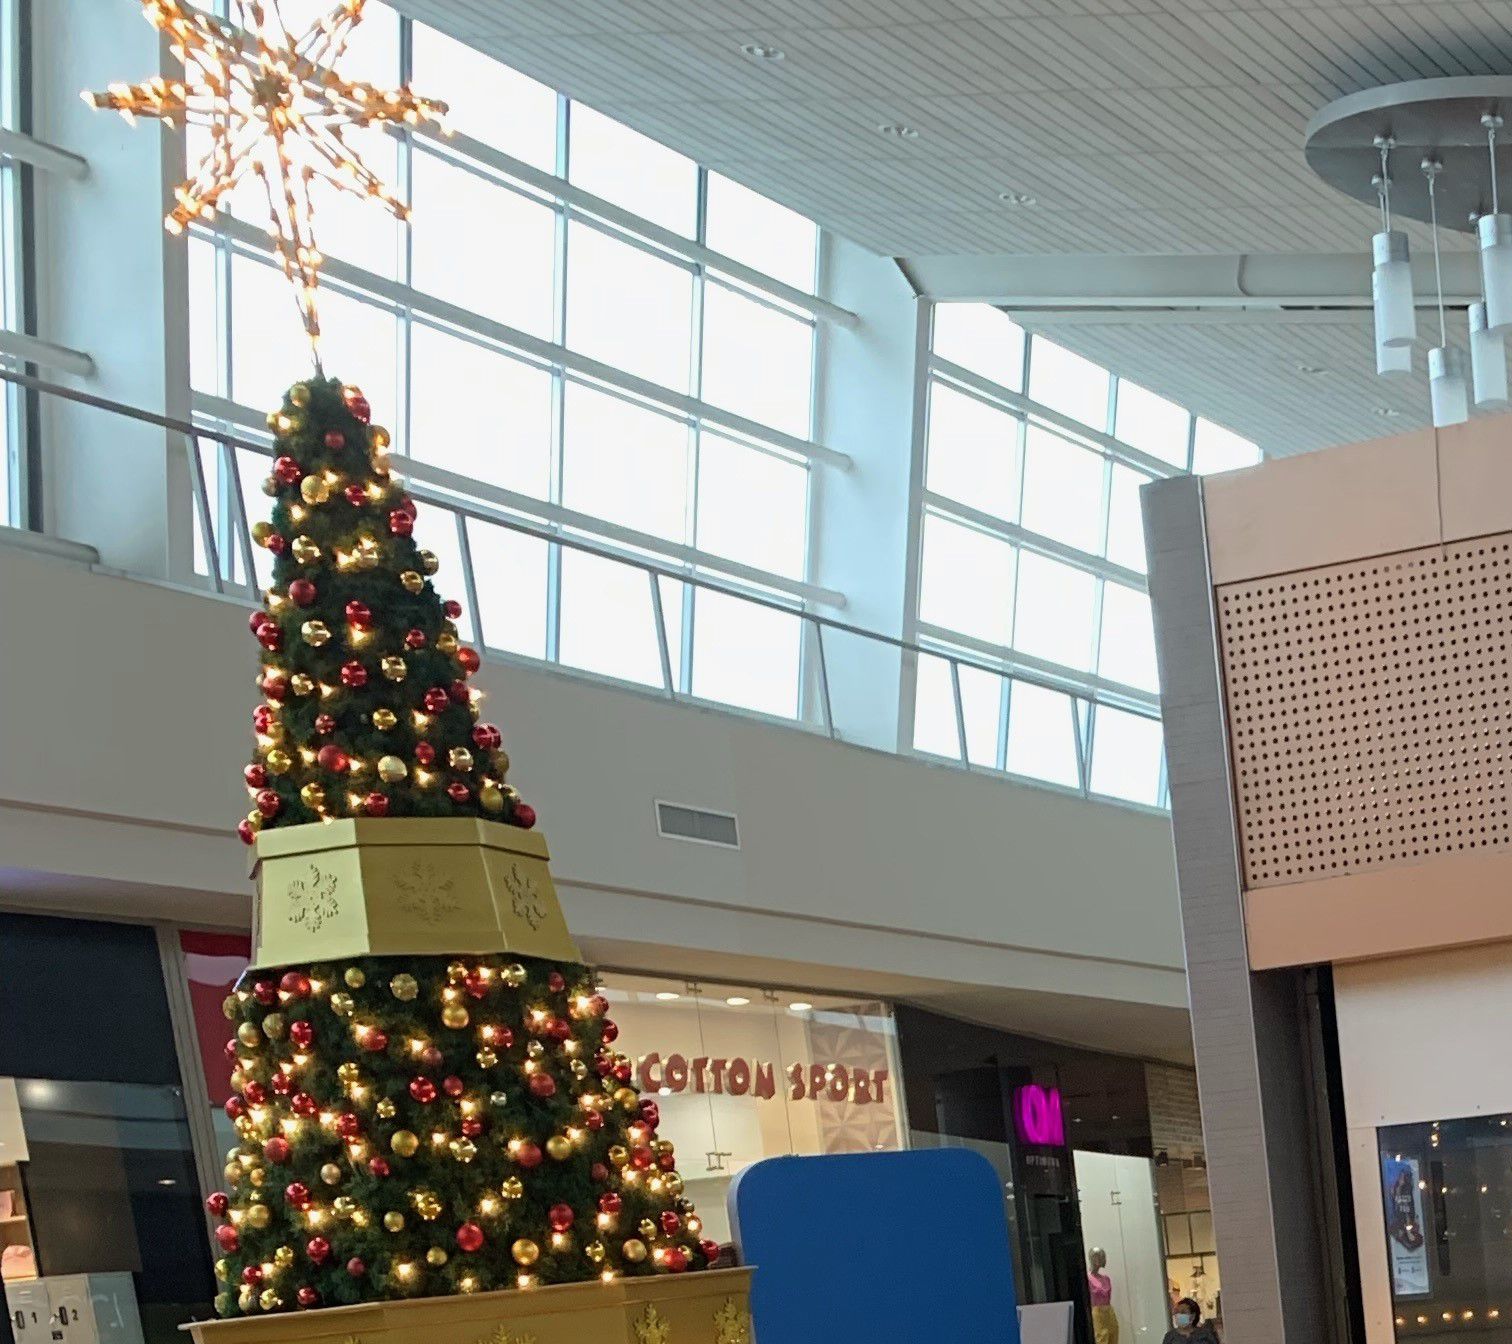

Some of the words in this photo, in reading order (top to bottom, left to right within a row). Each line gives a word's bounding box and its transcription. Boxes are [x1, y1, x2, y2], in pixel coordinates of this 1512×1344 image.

[640, 1052, 776, 1100] COTTON
[790, 1062, 889, 1104] SPORT
[72, 1308, 79, 1321] 2
